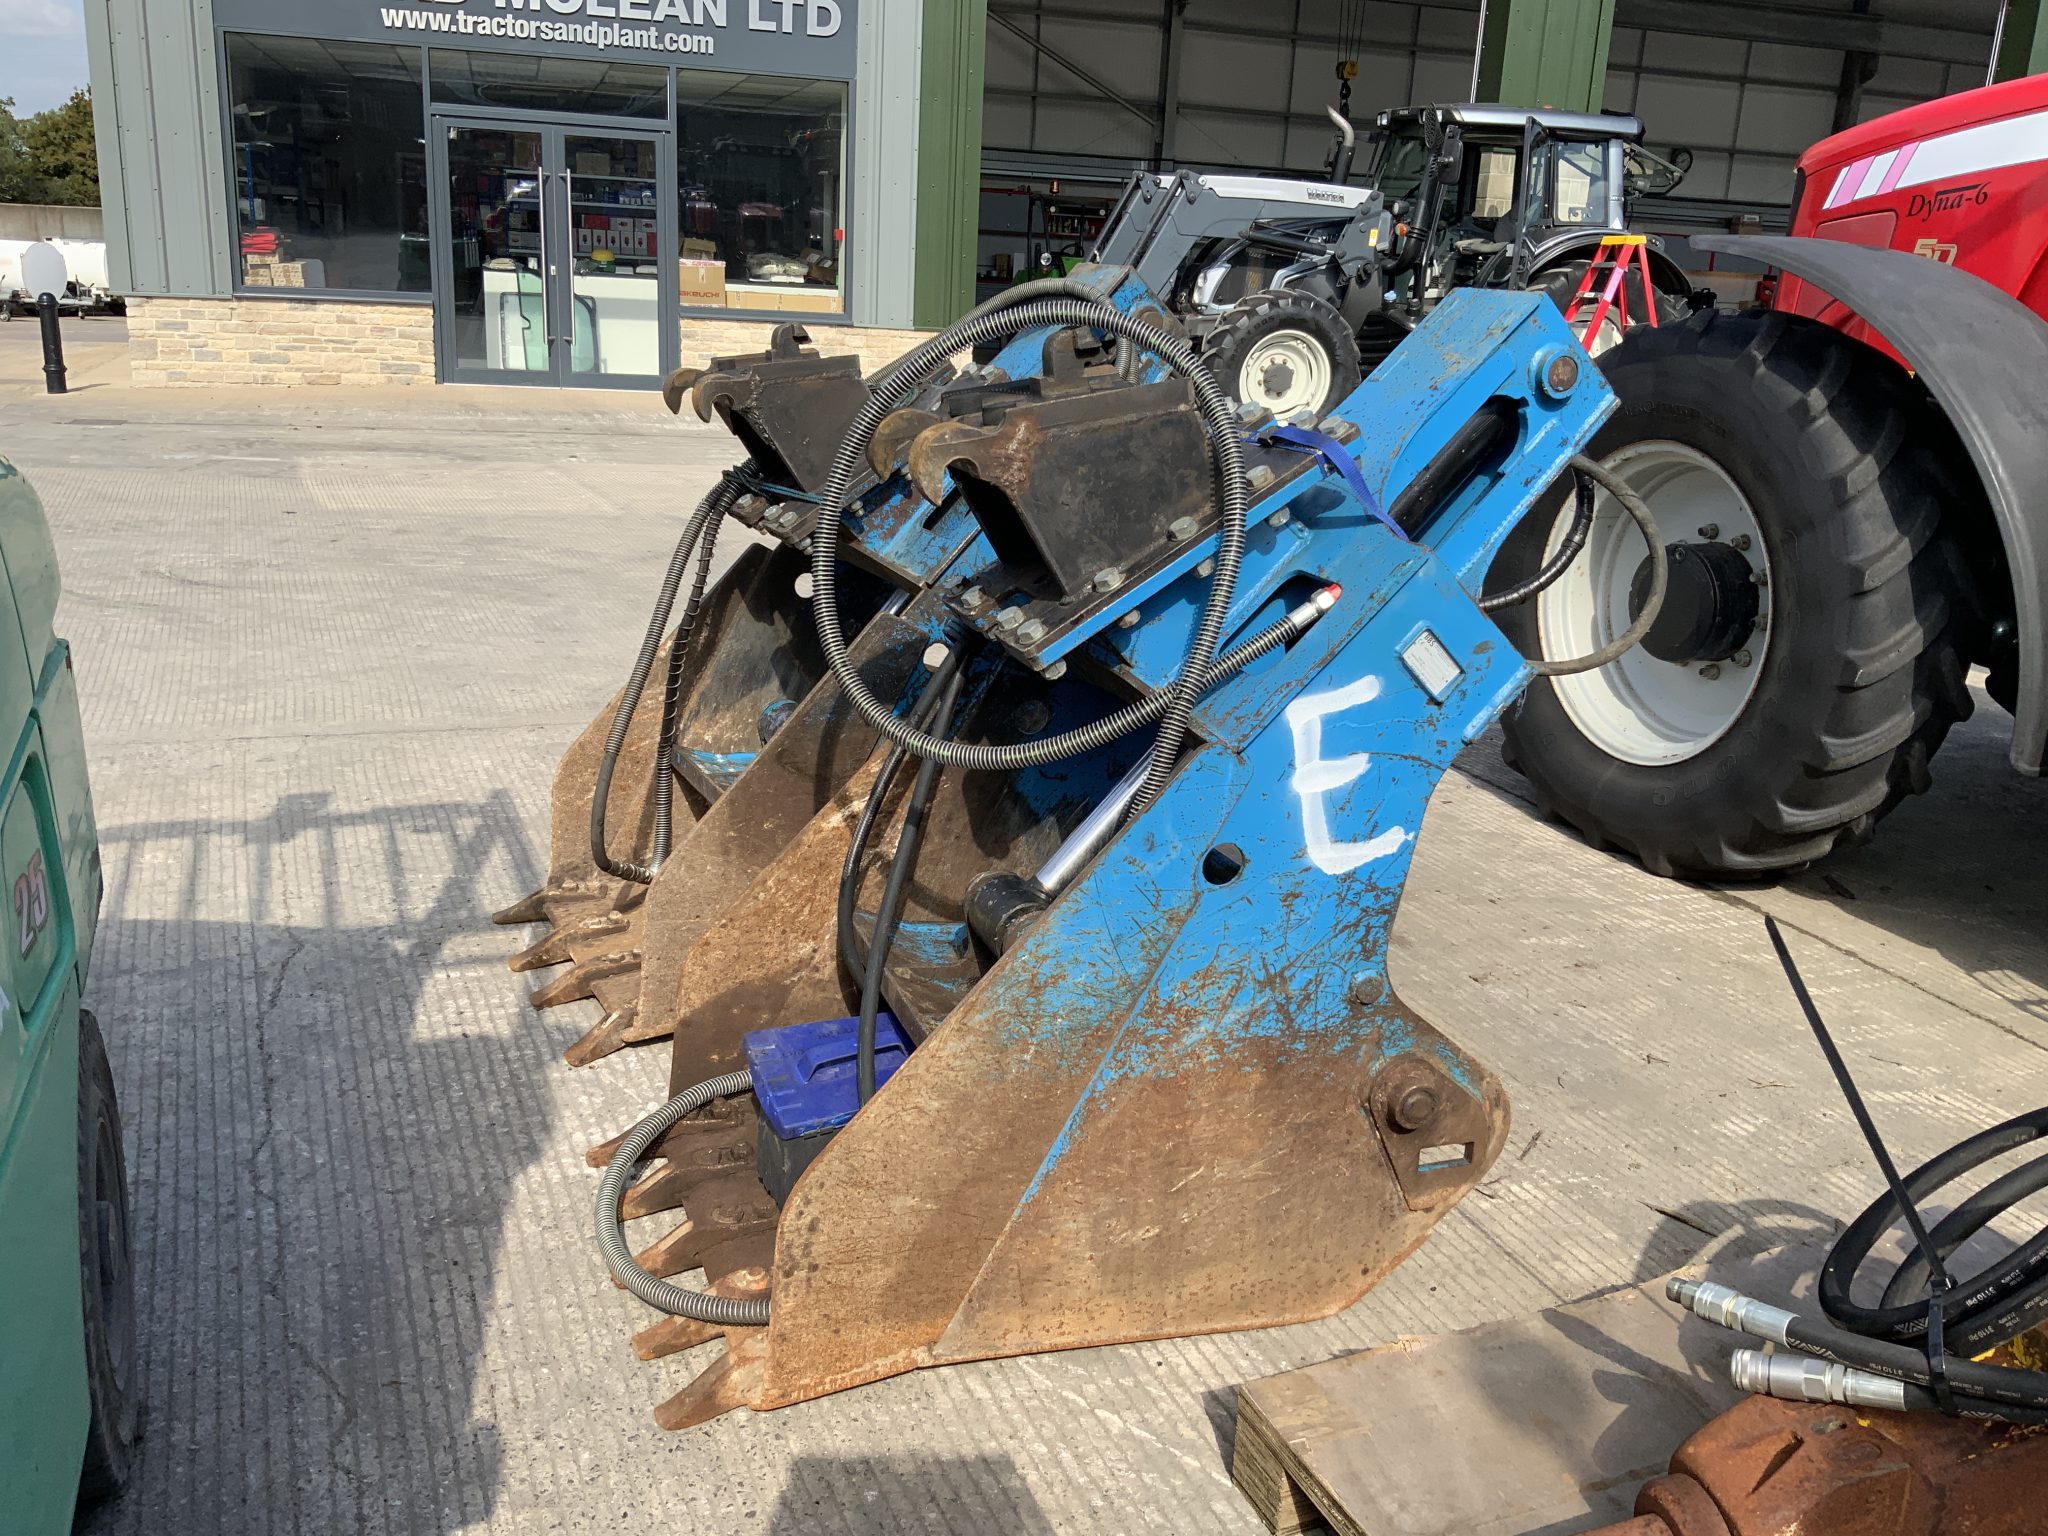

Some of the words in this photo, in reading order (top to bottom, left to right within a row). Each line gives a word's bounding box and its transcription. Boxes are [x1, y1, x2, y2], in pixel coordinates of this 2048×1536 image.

[381, 8, 714, 54] www.tractorsandplant.com
[495, 0, 727, 27] LEAN
[748, 0, 842, 37] LTD
[1906, 181, 1992, 222] Dyna-6
[1286, 674, 1415, 875] E
[14, 848, 48, 961] 25
